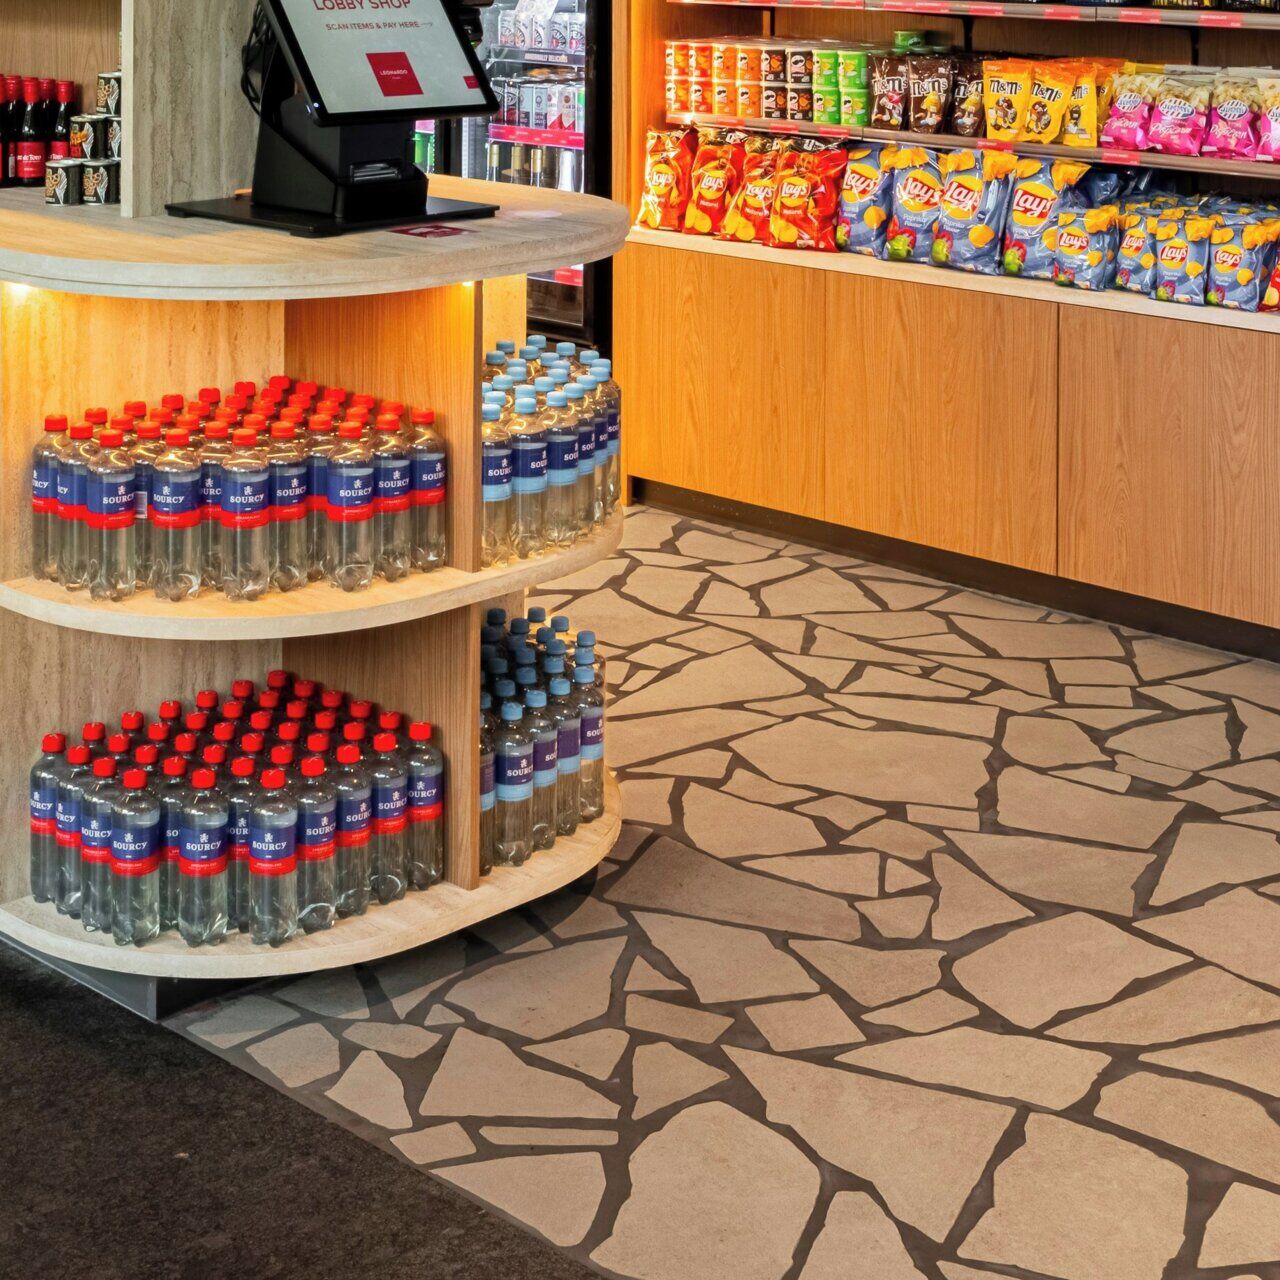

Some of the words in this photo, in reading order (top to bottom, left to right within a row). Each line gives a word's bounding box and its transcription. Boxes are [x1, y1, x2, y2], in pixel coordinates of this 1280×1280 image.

[326, 23, 350, 31] SCAN
[781, 184, 808, 197] Lay's
[1014, 189, 1053, 214] Lay's
[1059, 232, 1088, 247] Lay's
[1162, 246, 1187, 261] Lay's
[423, 471, 445, 480] SOURC
[379, 478, 409, 488] SOURCY
[277, 486, 306, 497] SOURCY
[340, 487, 371, 497] SOURCY
[103, 492, 134, 504] SOURCY
[153, 493, 184, 504] SOURCY
[230, 493, 264, 504] SOURCY
[507, 768, 533, 776] SOURC
[81, 827, 111, 838] SOURCY
[226, 826, 248, 835] SOUR
[306, 824, 335, 836] SOURCY
[112, 840, 147, 851] SOURCY
[186, 841, 221, 851] SOURCY
[252, 841, 286, 851] SOURCY
